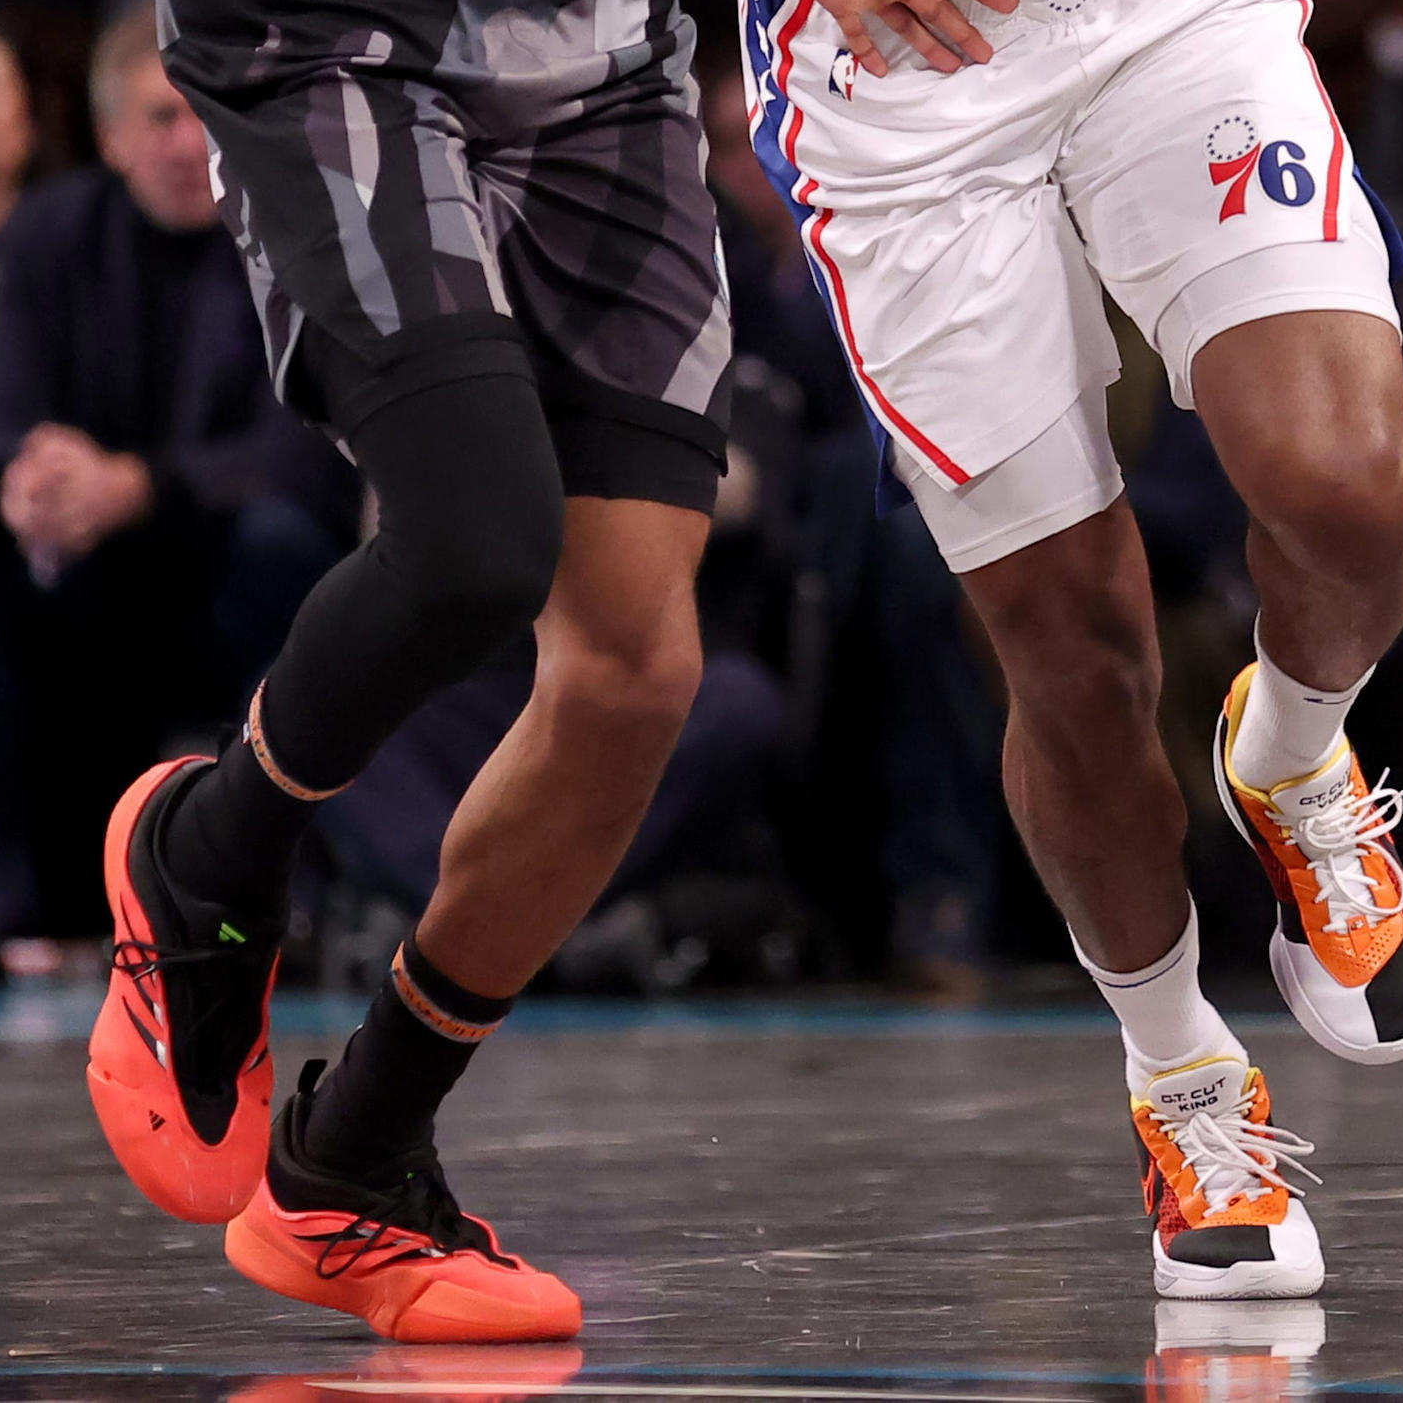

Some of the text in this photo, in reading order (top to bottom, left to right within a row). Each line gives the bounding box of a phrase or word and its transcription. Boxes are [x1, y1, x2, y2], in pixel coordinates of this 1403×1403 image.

[1208, 139, 1316, 225] 76
[1190, 1076, 1227, 1100] CUT
[1178, 1095, 1219, 1113] KING
